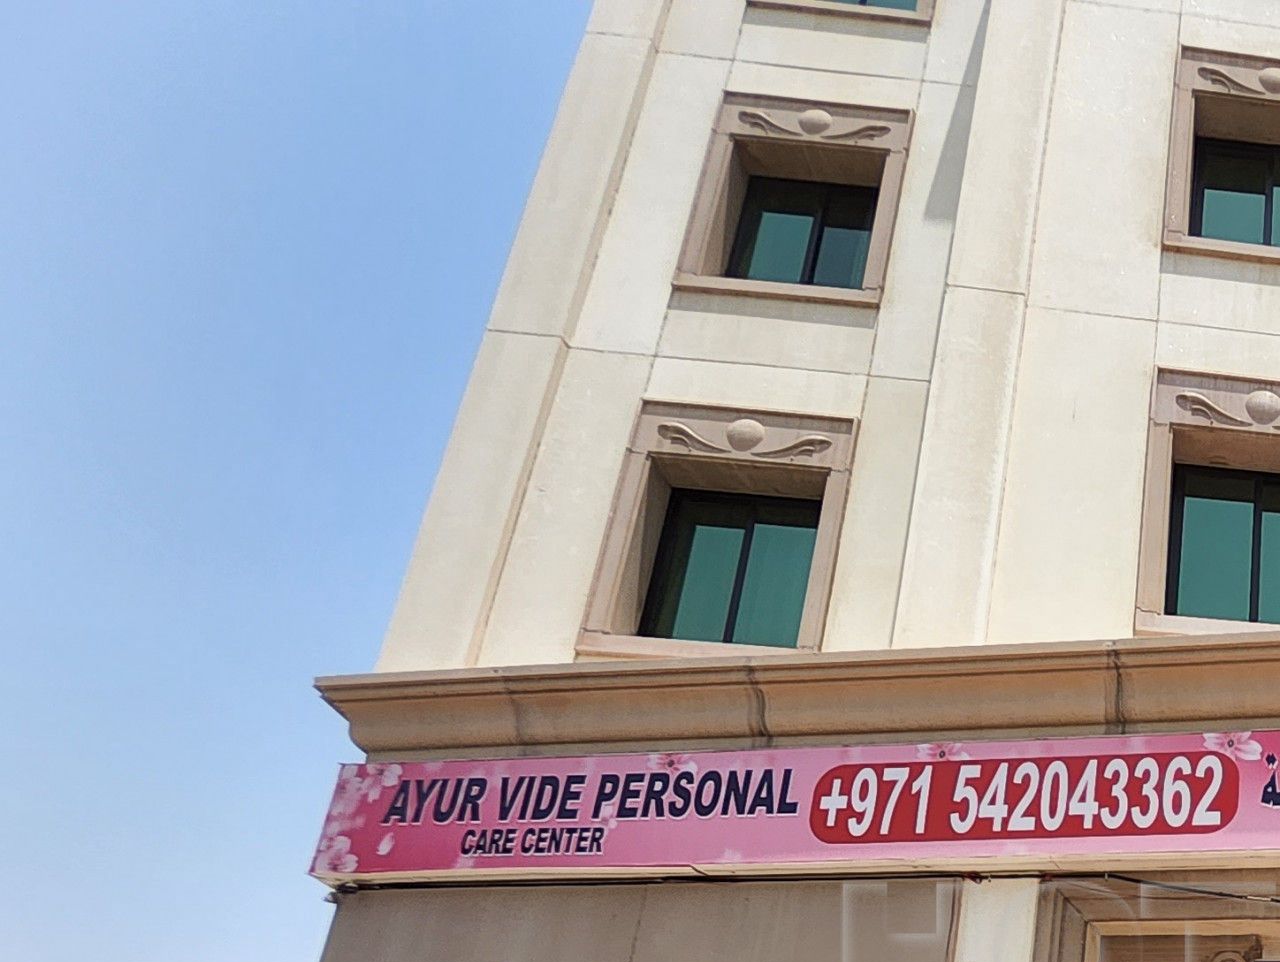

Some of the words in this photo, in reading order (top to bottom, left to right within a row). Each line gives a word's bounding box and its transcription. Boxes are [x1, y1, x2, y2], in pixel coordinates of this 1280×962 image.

[382, 777, 487, 825] AYUR
[499, 774, 586, 823] VIDE
[592, 769, 799, 821] PERSONAL
[819, 765, 933, 837] +971
[950, 755, 1224, 834] 542043362
[461, 829, 516, 856] CARE
[520, 827, 605, 855] CENTER
